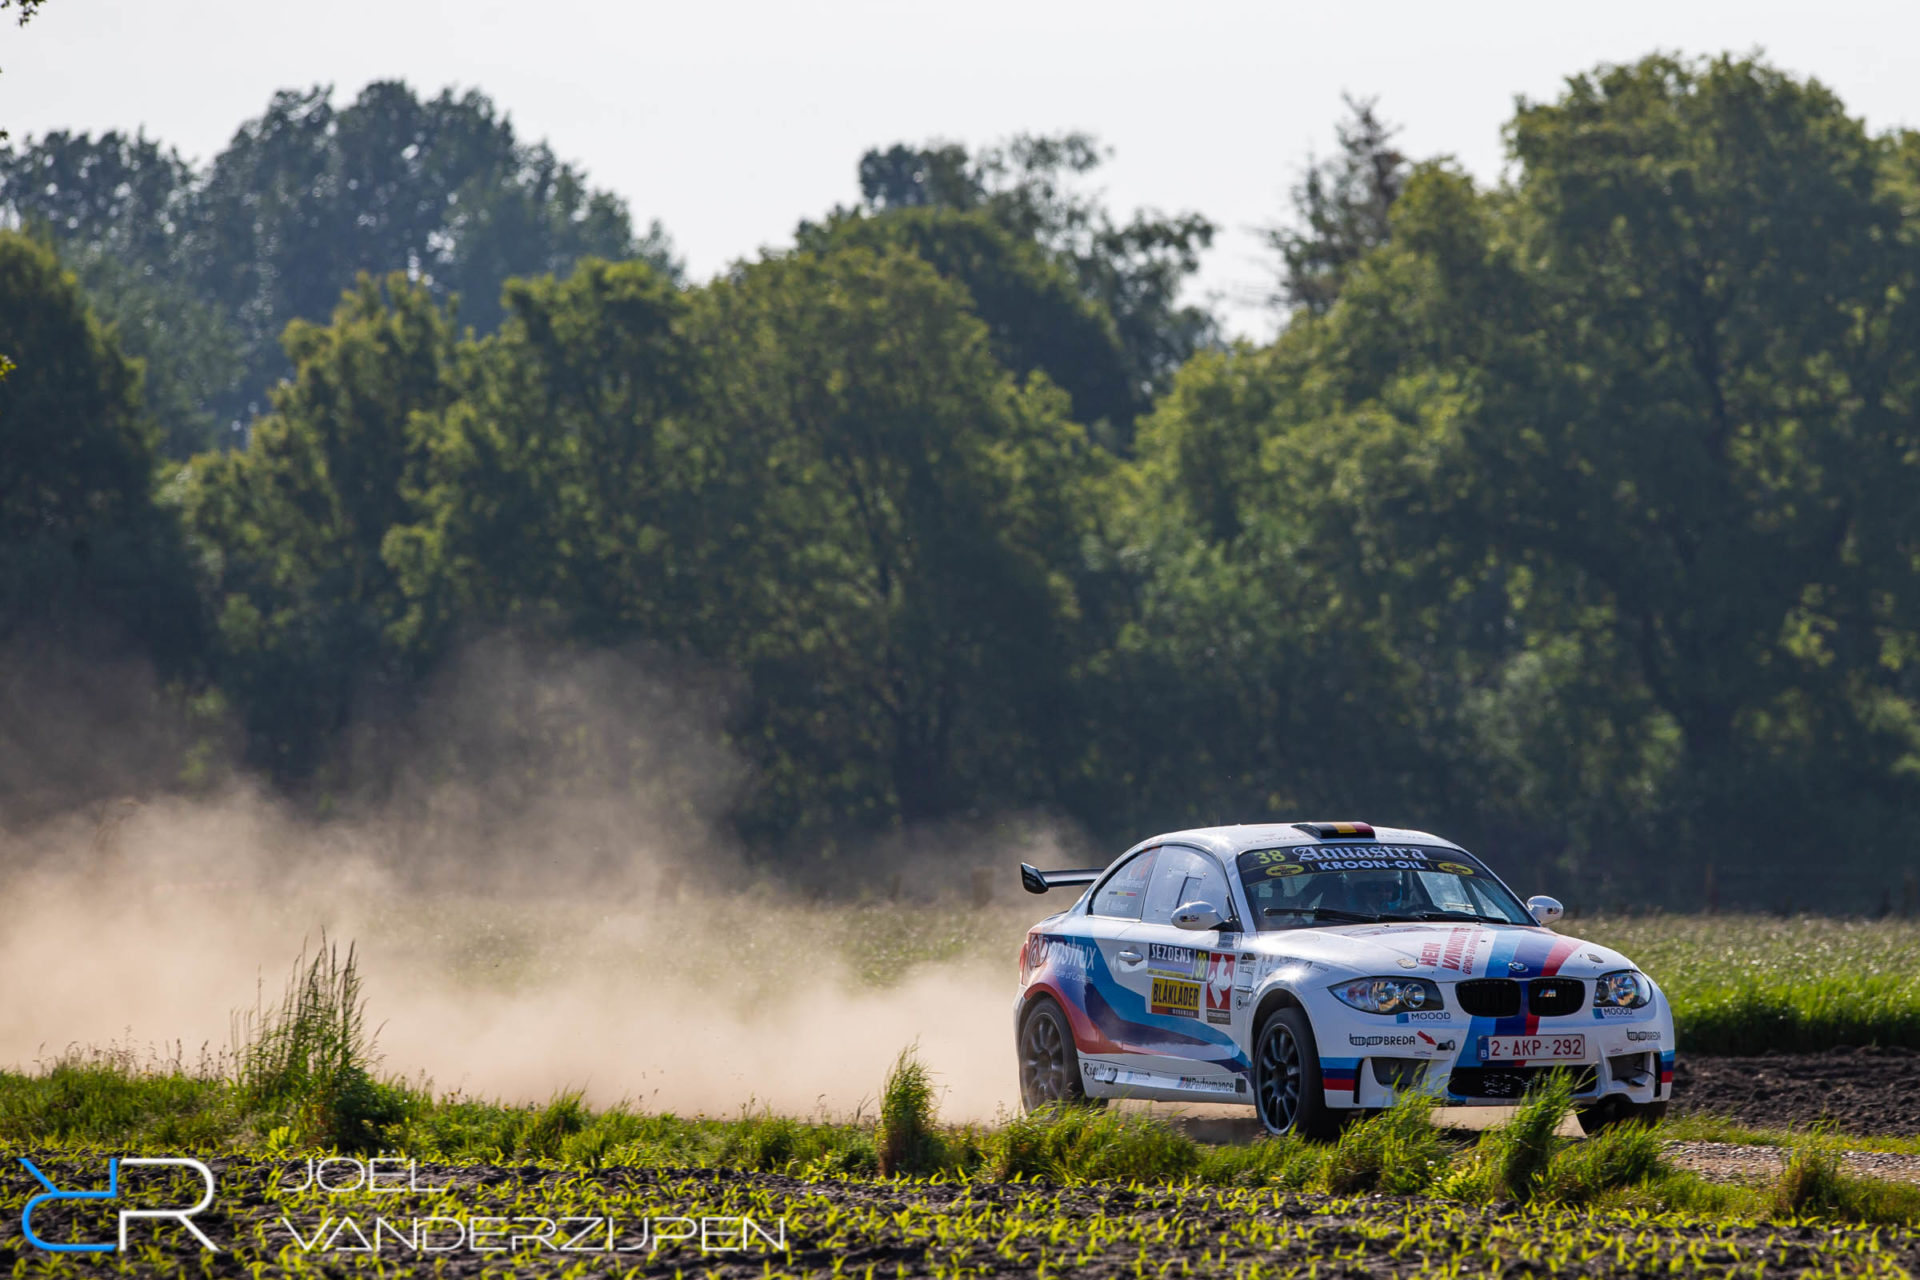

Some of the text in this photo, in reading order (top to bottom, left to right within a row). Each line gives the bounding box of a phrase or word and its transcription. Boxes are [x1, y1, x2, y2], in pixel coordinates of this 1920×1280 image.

[1254, 850, 1286, 865] 38
[1318, 860, 1426, 870] KROON-OIL
[1151, 944, 1191, 963] SEZOENS
[1411, 1012, 1451, 1020] MOOOD
[1384, 1035, 1416, 1046] BREDA
[1480, 1049, 1487, 1057] B
[1491, 1039, 1582, 1057] 2-AKP-292
